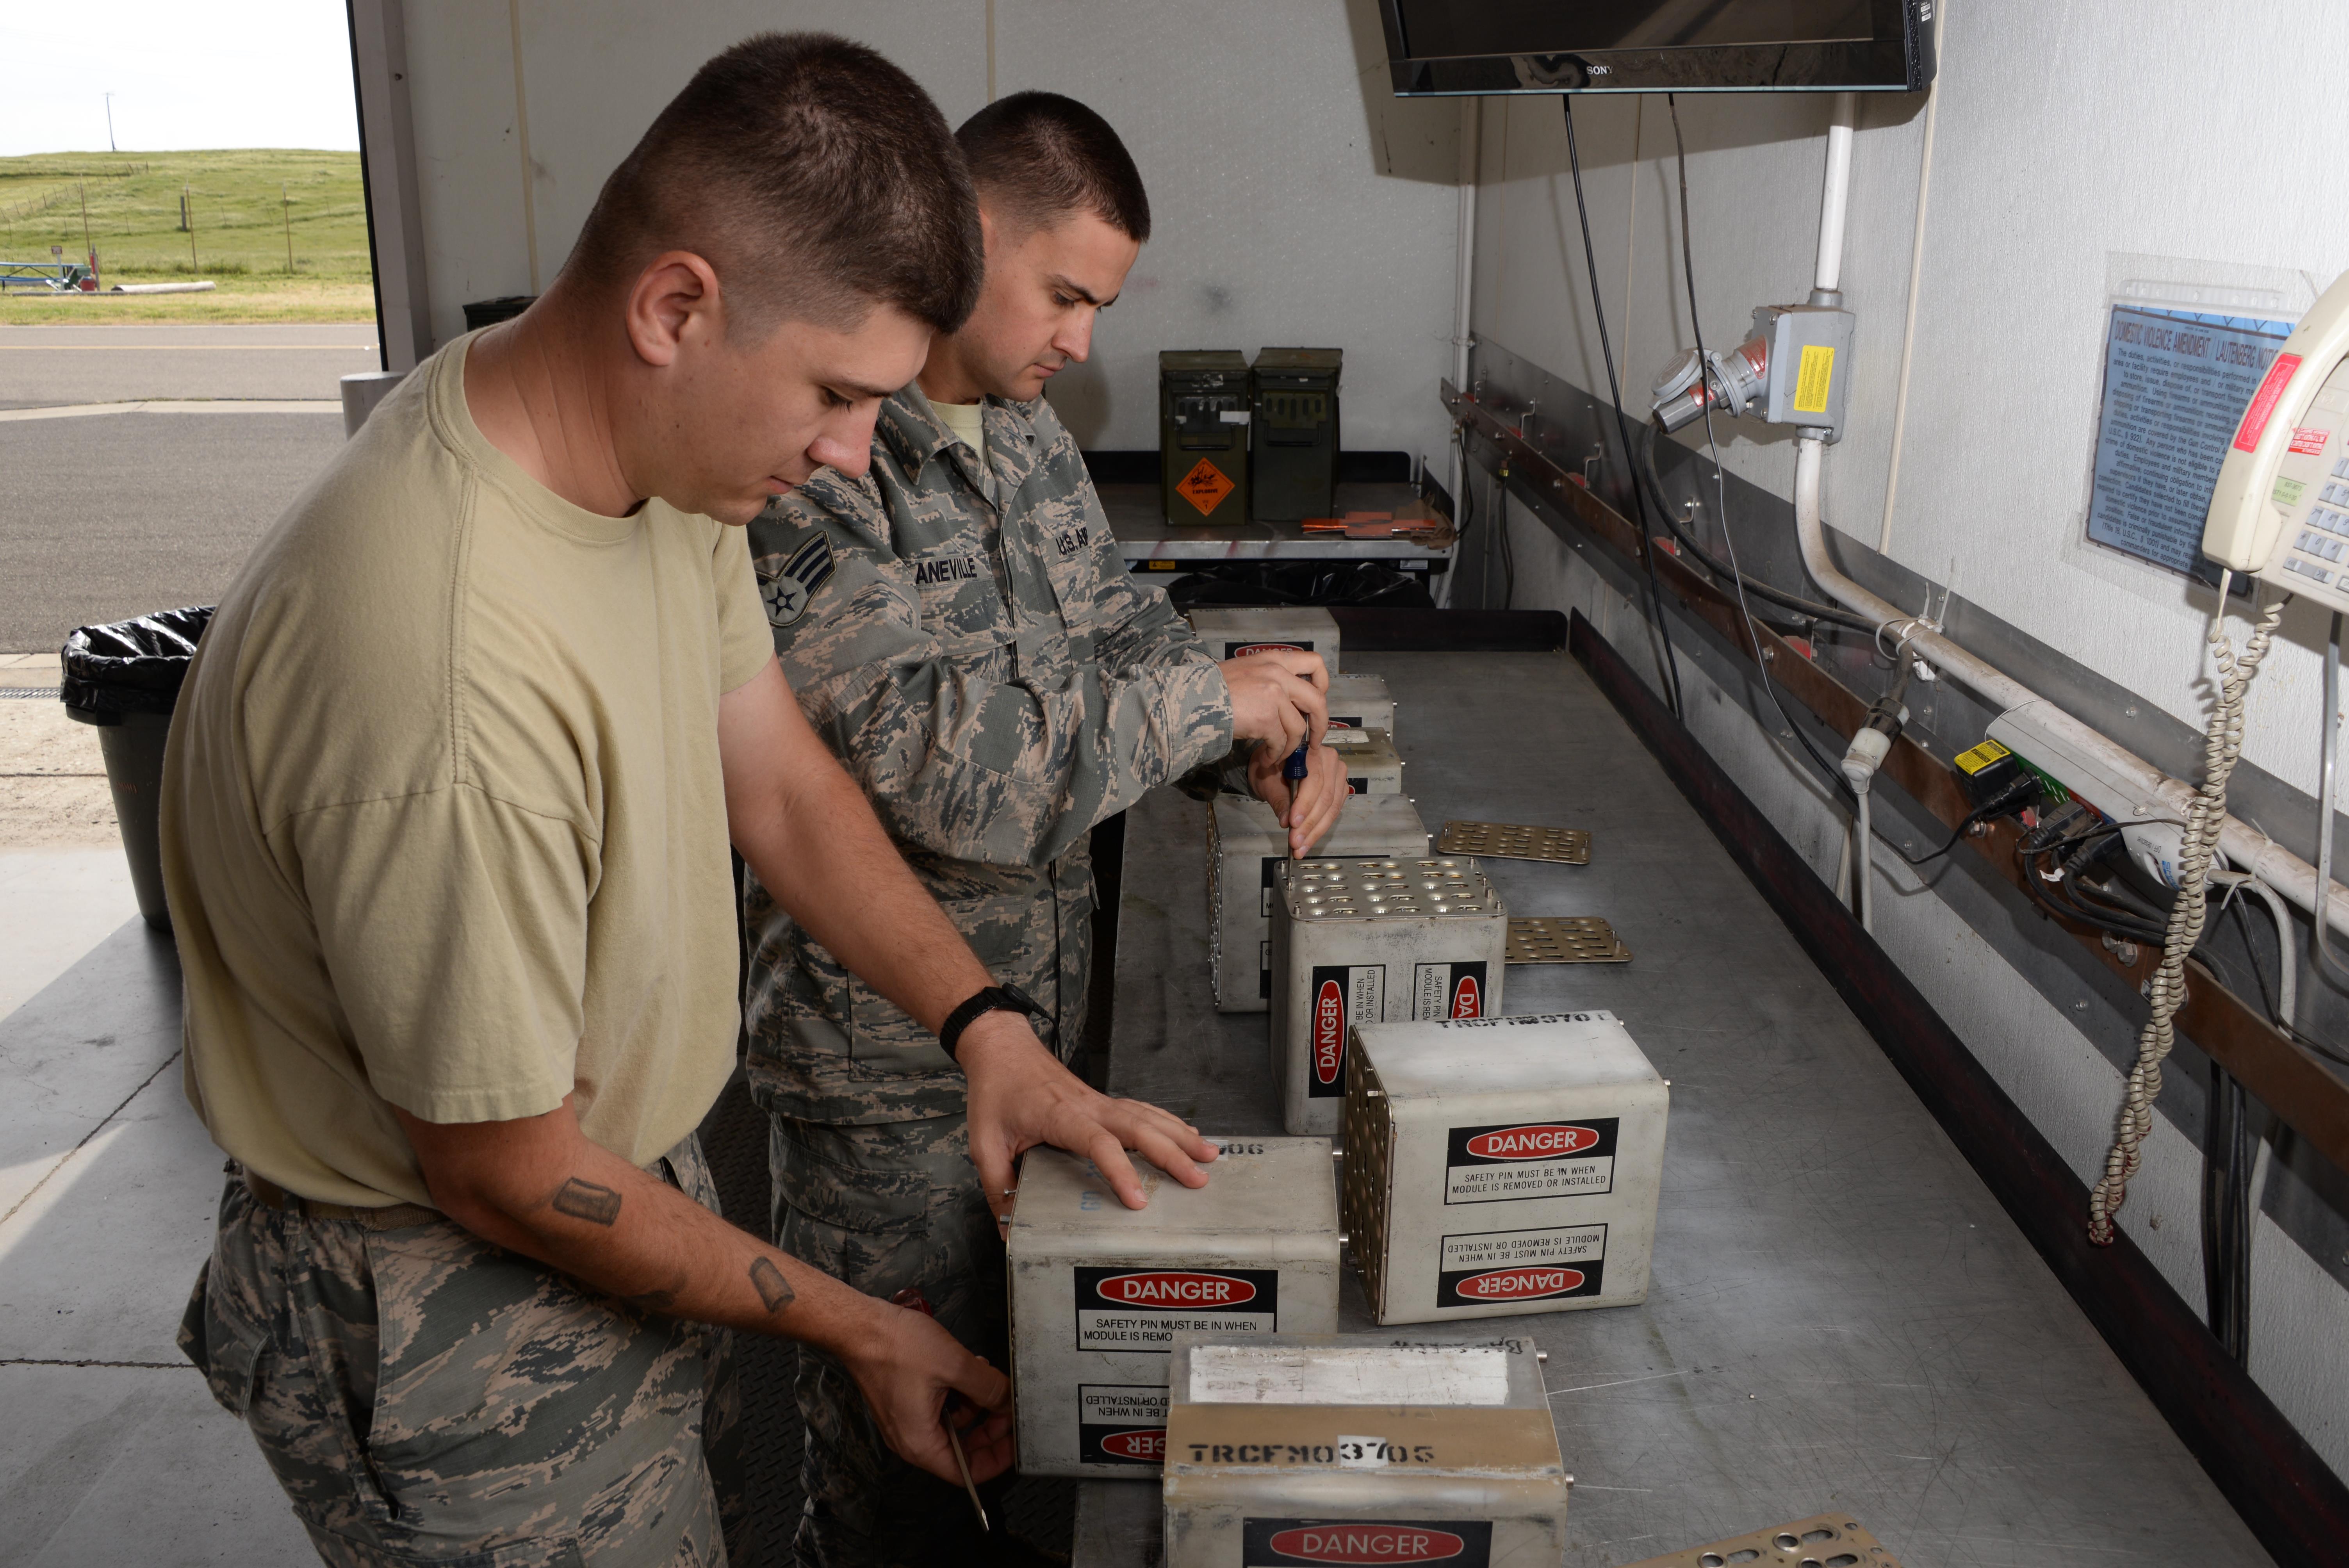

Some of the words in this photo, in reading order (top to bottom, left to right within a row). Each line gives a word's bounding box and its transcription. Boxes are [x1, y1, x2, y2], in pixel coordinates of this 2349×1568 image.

[1586, 66, 1613, 75] SONY
[2114, 321, 2143, 345] DOMESTIC
[2144, 326, 2173, 351] VIOLENCE
[2173, 331, 2211, 358] AMENDMENT
[2215, 340, 2256, 368] LAUTENBERG
[2118, 348, 2126, 357] The
[2222, 371, 2250, 383] performed
[2132, 362, 2149, 374] facility
[2126, 442, 2148, 454] domestic
[2146, 438, 2156, 448] Any
[2188, 450, 2198, 458] has
[2200, 452, 2213, 462] been
[2200, 441, 2220, 453] Control
[2143, 469, 2169, 482] continuing
[2170, 477, 2194, 489] obligation
[2143, 478, 2153, 488] they
[2176, 488, 2188, 497] later
[2125, 481, 2152, 496] Candidates
[2191, 503, 2205, 513] these
[1055, 534, 1078, 556] U.S.
[2121, 539, 2150, 554] commanders
[2160, 553, 2188, 568] appropriate
[2171, 547, 2181, 557] may
[916, 558, 977, 584] ANEVILLE
[2153, 845, 2162, 853] OFF
[1366, 969, 1375, 1006] INSTALLED
[1424, 968, 1433, 997] MODULE
[1356, 978, 1365, 1000] WHEN
[1434, 976, 1442, 1003] SAFETY
[1458, 994, 1474, 1017] DA
[1356, 1010, 1363, 1020] BE
[1365, 1009, 1373, 1018] OR
[1320, 997, 1338, 1067] DANGER
[1488, 1131, 1577, 1153] DANGER
[1465, 1173, 1494, 1183] SAFETY
[1499, 1171, 1513, 1180] PIN
[1517, 1169, 1540, 1179] MUST
[1544, 1168, 1554, 1177] BE
[1558, 1167, 1567, 1176] IN
[1571, 1165, 1595, 1175] WHEN
[1452, 1184, 1487, 1194] MODULE
[1491, 1183, 1499, 1191] IS
[1503, 1180, 1542, 1190] REMOVED
[1547, 1179, 1558, 1187] OR
[1562, 1175, 1606, 1186] INSTALLED
[1511, 1238, 1550, 1248] REMOVED
[1554, 1237, 1562, 1245] IS
[1565, 1234, 1600, 1244] MODULE
[1448, 1243, 1492, 1253] INSTALLED
[1496, 1241, 1507, 1250] OR
[1558, 1245, 1587, 1255] SAFETY
[1500, 1251, 1510, 1260] BE
[1514, 1249, 1536, 1258] MUST
[1540, 1248, 1554, 1256] PIN
[1459, 1254, 1483, 1263] WHEN
[1477, 1272, 1564, 1294] DANGER
[1124, 1280, 1230, 1300] DANGER
[1096, 1319, 1137, 1329] SAFETY
[1141, 1319, 1157, 1329] PIN
[1161, 1320, 1191, 1330] MUST
[1194, 1321, 1208, 1330] BE
[1211, 1321, 1221, 1330] IN
[1224, 1321, 1257, 1331] WHEN
[1084, 1331, 1127, 1340] MODULE
[1130, 1331, 1139, 1341] IS
[1142, 1332, 1173, 1342] REMO
[1086, 1396, 1140, 1405] INSTALLED
[1143, 1397, 1157, 1406] OR
[1098, 1407, 1130, 1416] WHEN
[1133, 1408, 1143, 1417] IN
[1146, 1408, 1159, 1417] BE
[1126, 1436, 1166, 1454] GER
[1303, 1533, 1429, 1556] DANGER
